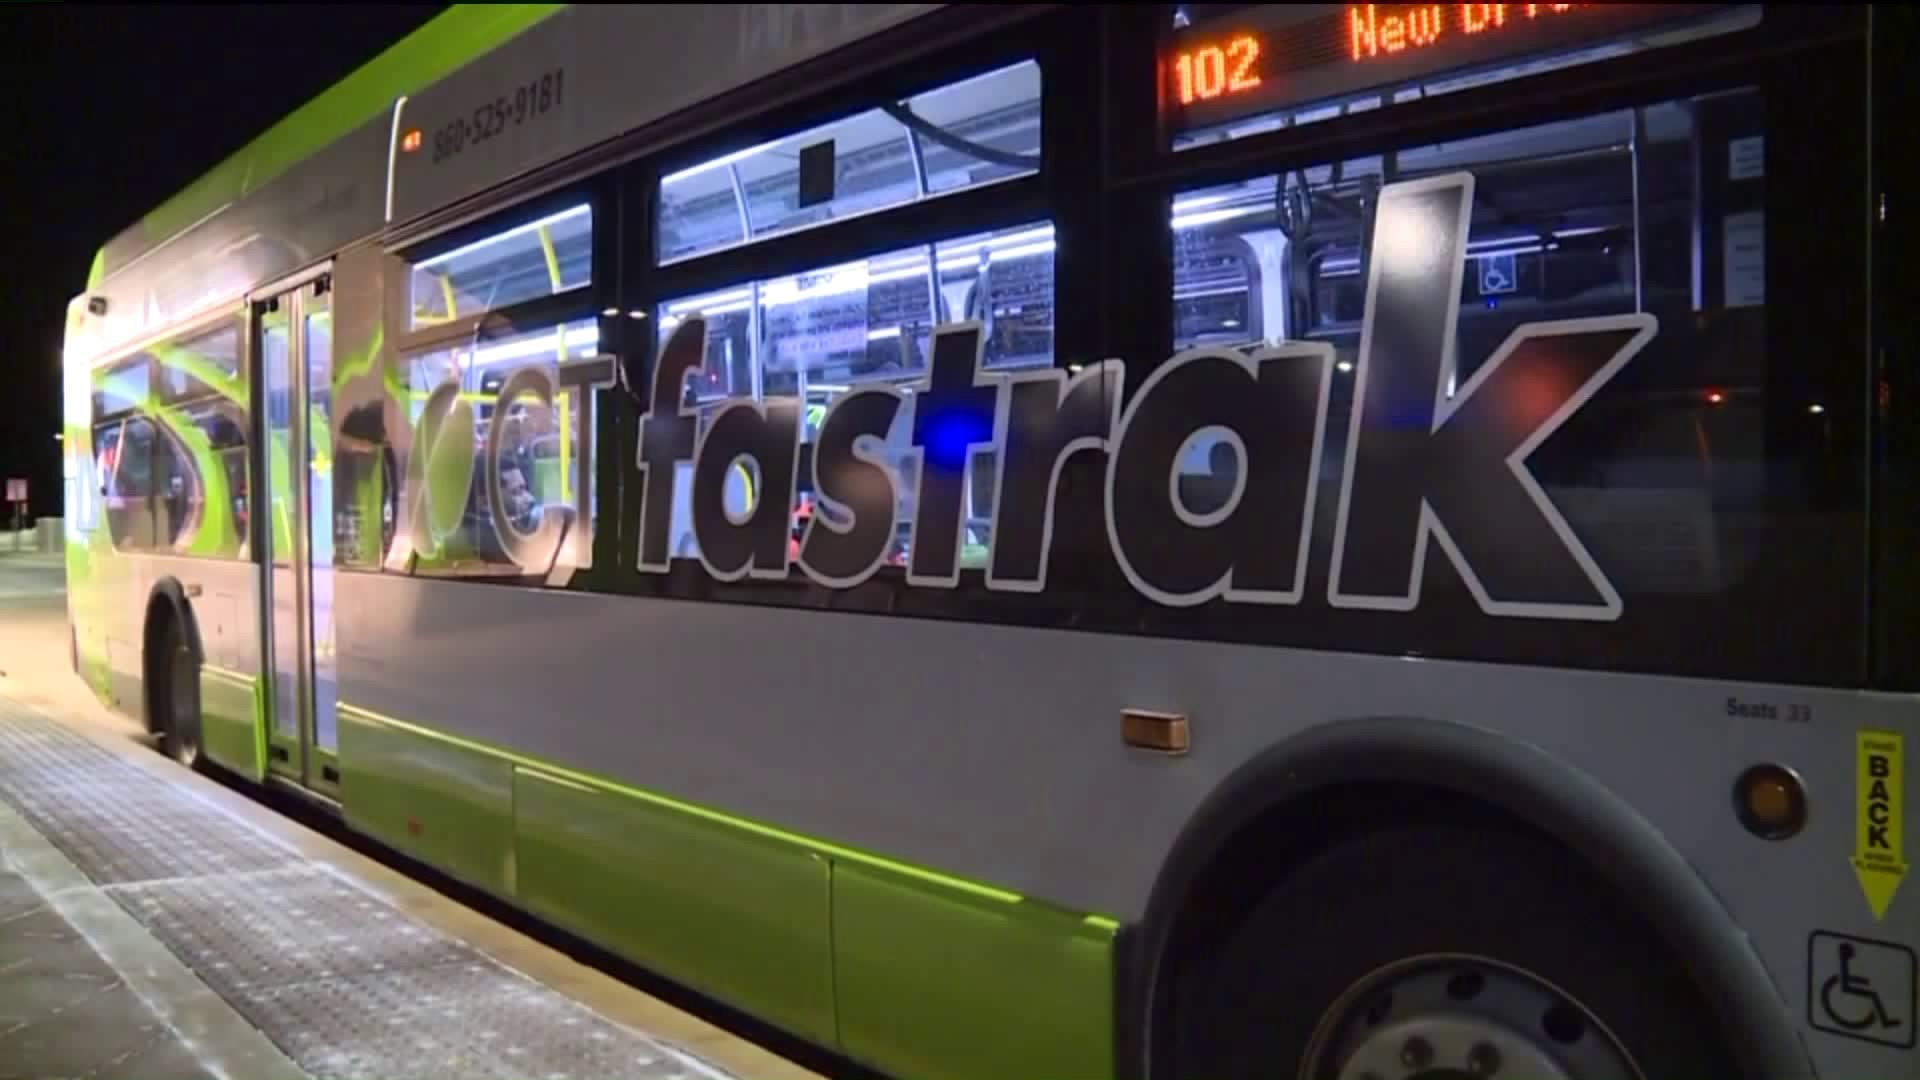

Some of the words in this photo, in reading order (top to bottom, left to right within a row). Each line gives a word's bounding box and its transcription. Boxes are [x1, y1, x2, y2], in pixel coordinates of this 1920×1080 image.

[1174, 36, 1262, 104] 102
[1347, 4, 1441, 61] New
[1727, 697, 1777, 720] Seats
[1868, 754, 1891, 850] BACK
